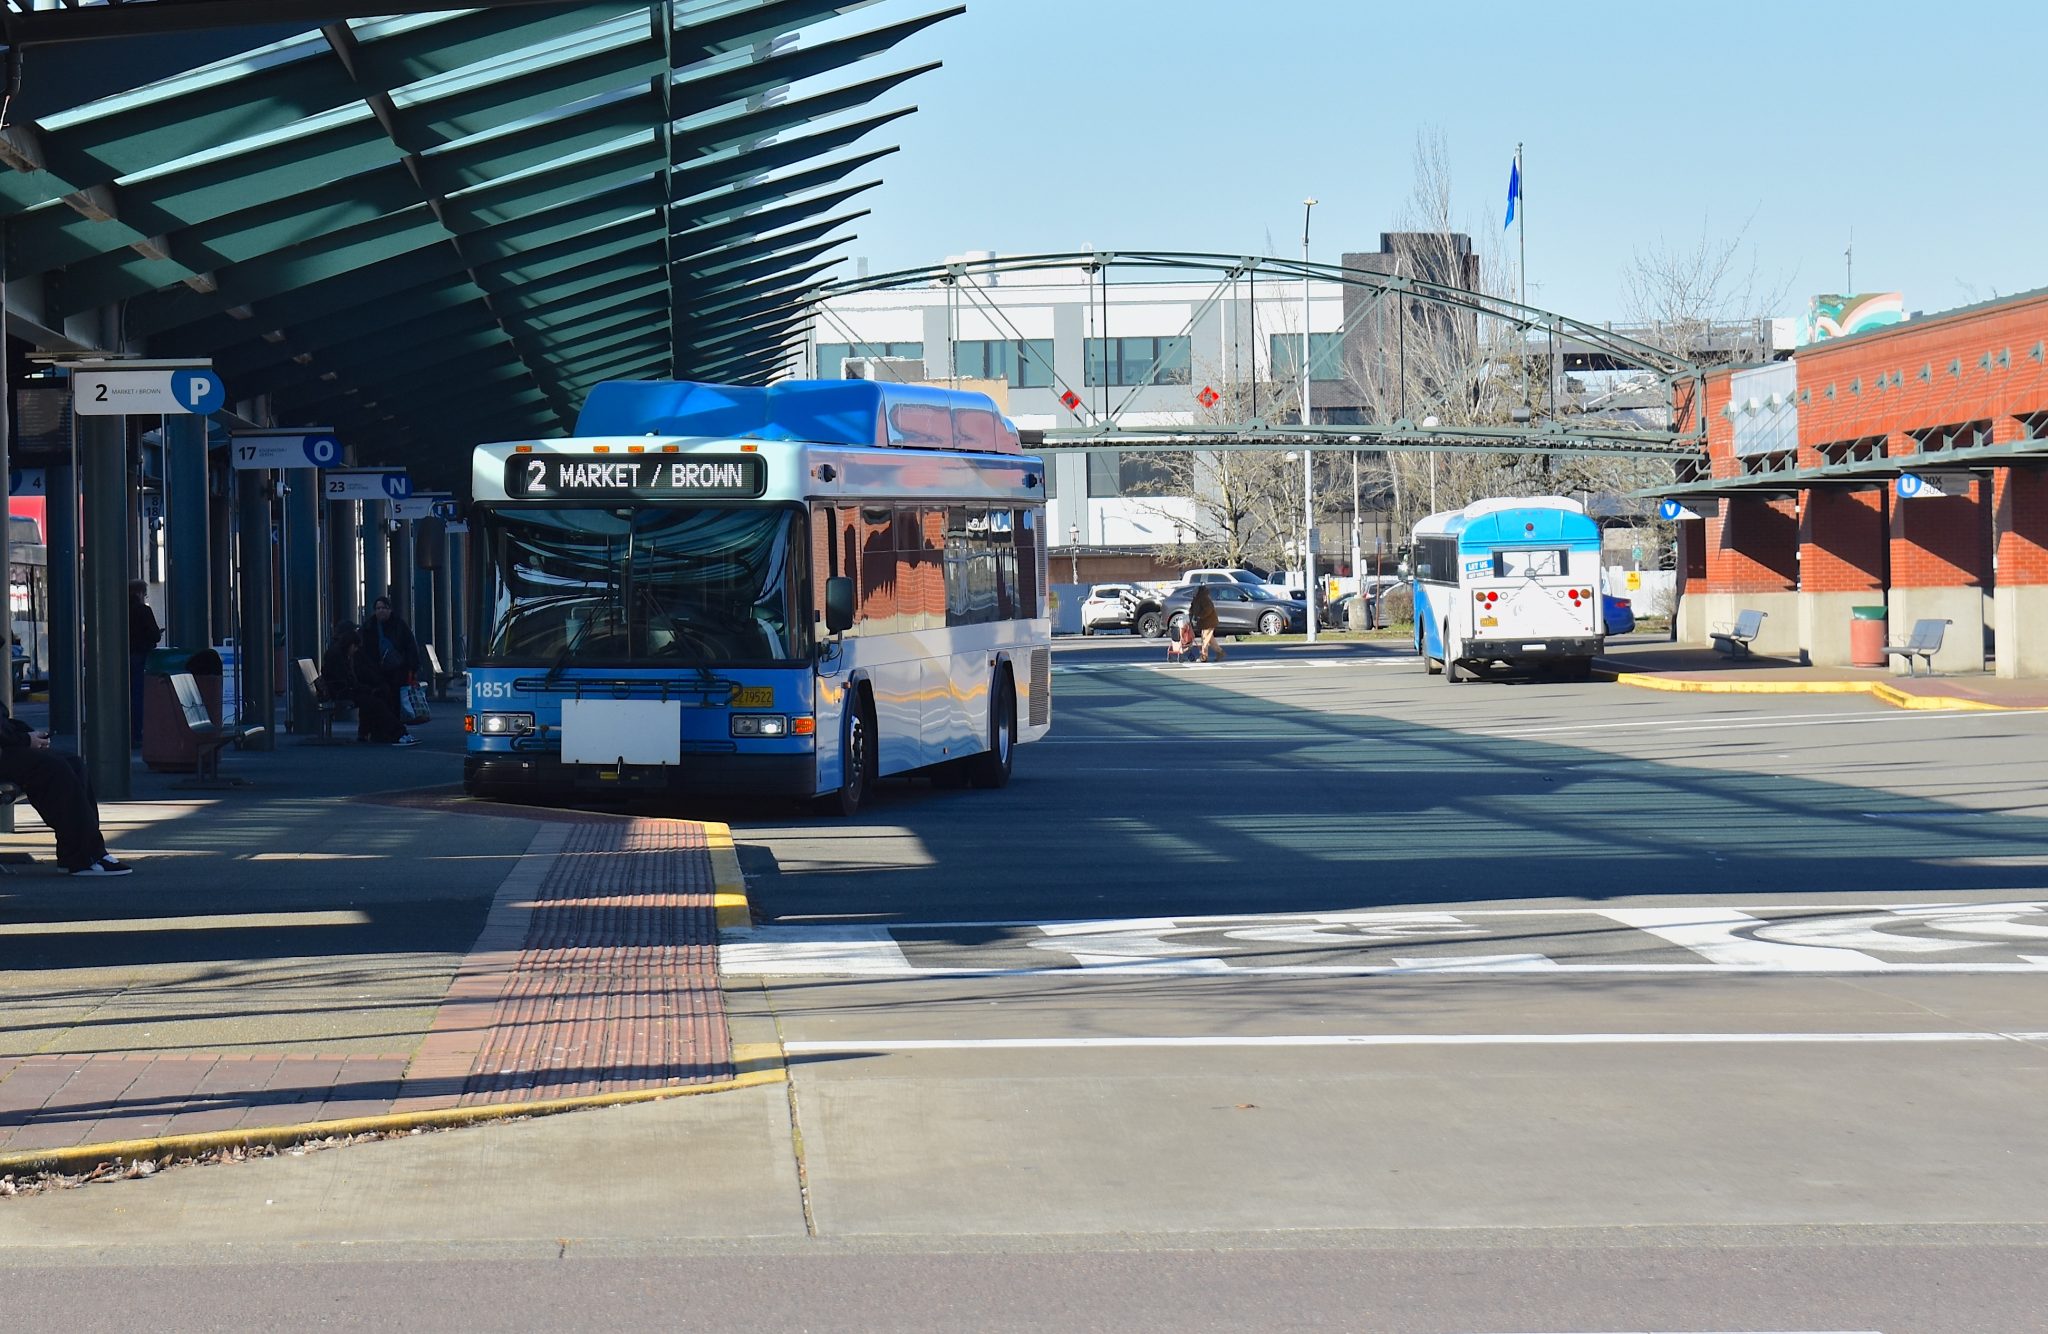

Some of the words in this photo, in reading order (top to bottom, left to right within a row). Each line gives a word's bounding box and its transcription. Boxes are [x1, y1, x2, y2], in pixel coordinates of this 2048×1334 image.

[95, 384, 108, 401] 2
[190, 377, 211, 405] P
[239, 446, 257, 460] 17
[313, 440, 334, 462] O
[32, 476, 41, 489] 4
[527, 460, 546, 491] 2
[560, 463, 641, 488] MARKET
[650, 463, 662, 488] /
[671, 463, 743, 488] BROWN
[1923, 475, 1943, 485] 30X
[329, 481, 345, 493] 23
[389, 477, 406, 495] N
[1901, 477, 1916, 493] U
[146, 507, 159, 517] 18
[395, 504, 402, 513] 5
[1664, 503, 1676, 516] V
[475, 681, 511, 698] 1851
